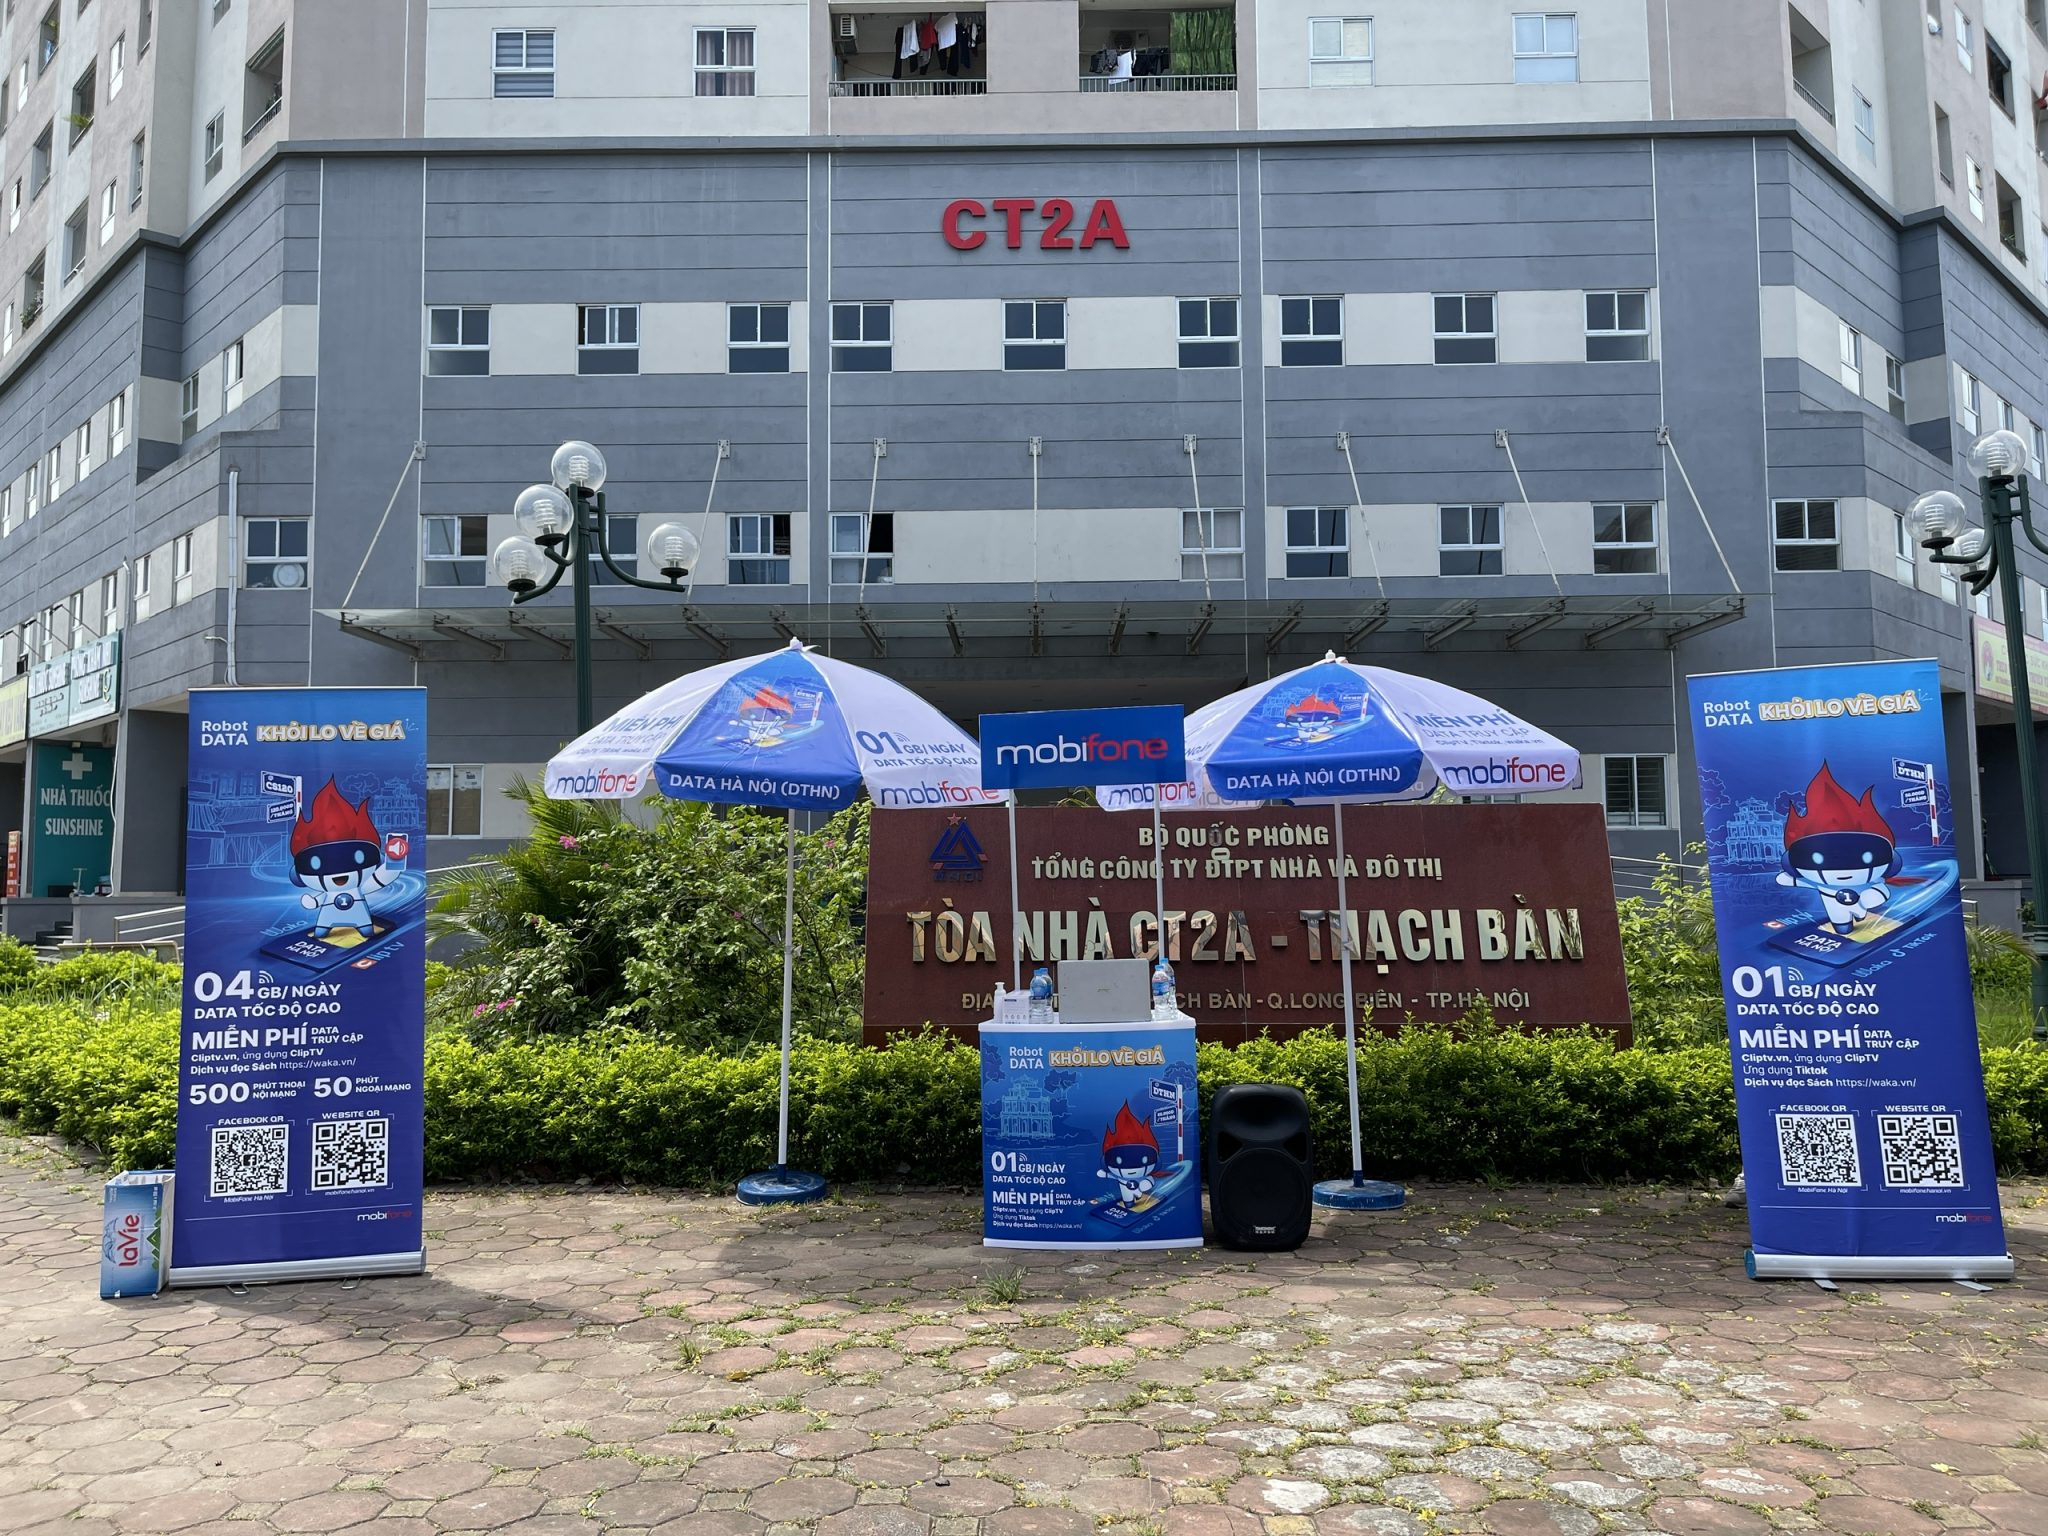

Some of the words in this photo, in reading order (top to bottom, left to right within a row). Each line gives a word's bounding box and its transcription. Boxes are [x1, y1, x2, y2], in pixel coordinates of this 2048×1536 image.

[943, 198, 1130, 250] CT2A
[1703, 700, 1751, 713] Robot
[1758, 697, 1814, 722] KHỎI
[1815, 699, 1846, 717] LO
[1845, 693, 1878, 716] VỀ
[1878, 690, 1921, 713] GIÁ
[1468, 708, 1517, 727] PHÍ
[1704, 713, 1753, 728] DATA
[201, 720, 248, 732] Robot
[256, 720, 308, 742] KHỎI
[310, 725, 338, 741] LO
[338, 721, 367, 741] VỀ
[369, 720, 406, 740] GIÁ
[201, 733, 248, 746] DATA
[1422, 729, 1458, 738] DATA
[1459, 729, 1498, 738] TRUY
[856, 730, 903, 755] 01
[904, 743, 928, 755] GB/
[931, 741, 966, 753] NGÀY
[996, 733, 1168, 765] mobifone
[874, 758, 908, 768] DATA
[910, 757, 933, 766] TỐC
[936, 756, 952, 767] ĐỘ
[954, 757, 978, 766] CAO
[1442, 757, 1566, 784] mobifone
[554, 768, 637, 793] mobifone
[1227, 775, 1273, 790] DATA
[1277, 771, 1301, 787] HÀ
[1305, 768, 1334, 786] NỘI
[1338, 766, 1400, 783] (DTHN)
[1897, 766, 1925, 780] DTHN
[41, 785, 66, 806] NHÀ
[71, 784, 110, 806] THUỐC
[266, 781, 293, 793] CS120
[670, 774, 715, 789] DATA
[721, 775, 743, 791] HÀ
[749, 778, 776, 793] NỘI
[781, 781, 840, 800] (DTHN)
[881, 781, 1000, 805] mobifone
[45, 818, 103, 836] SUNSHINE
[1138, 823, 1169, 850] BỘ
[1175, 821, 1240, 848] QUỐC
[1247, 822, 1330, 847] PHÒNG
[1032, 851, 1095, 879] TỔNG
[1100, 855, 1163, 879] CÔNG
[1170, 858, 1197, 879] TY
[1205, 858, 1263, 879] ĐTPT
[1270, 854, 1322, 879] NHÀ
[1366, 854, 1400, 878] ĐÔ
[1404, 858, 1443, 881] THỊ
[906, 898, 997, 963] TÒA
[1018, 897, 1113, 962] NHÀ
[1129, 910, 1257, 963] CT2A
[1300, 908, 1465, 975] THẠCH
[1476, 894, 1584, 961] BÀN
[194, 970, 254, 1002] 04
[258, 986, 288, 999] GB/
[292, 981, 341, 998] NGÀY
[1732, 966, 1785, 998] 01
[1788, 984, 1820, 998] GB/
[1825, 980, 1876, 997] NGÀY
[962, 993, 994, 1013] ĐỊA
[1208, 988, 1252, 1009] BÀN
[1267, 992, 1345, 1010] Q.LONG
[1355, 989, 1402, 1009] BIÊN
[1494, 988, 1530, 1011] NỘI
[1737, 1004, 1779, 1015] DATA
[1782, 1001, 1815, 1015] TỐC
[1817, 1001, 1842, 1017] ĐỘ
[1846, 1003, 1879, 1015] CAO
[195, 1007, 237, 1019] DATA
[241, 1002, 276, 1016] TỐC
[278, 1002, 301, 1017] ĐỘ
[305, 1002, 341, 1014] CAO
[192, 1025, 259, 1050] MIỄN
[265, 1022, 308, 1046] PHÍ
[312, 1027, 339, 1035] DATA
[312, 1035, 339, 1044] TRUY
[342, 1033, 364, 1044] CẬP
[1739, 1024, 1808, 1048] MIỄN
[1814, 1024, 1860, 1048] PHÍ
[1864, 1030, 1892, 1038] DATA
[1865, 1040, 1893, 1048] TRUY
[1896, 1038, 1919, 1049] CẬP
[191, 1053, 239, 1063] Cliptv.vn,
[242, 1051, 261, 1061] ứng
[264, 1050, 287, 1060] dụng
[290, 1048, 324, 1059] ClipTV
[1010, 1047, 1043, 1057] Robot
[1050, 1048, 1088, 1066] KHỎI
[1089, 1051, 1112, 1066] LO
[1111, 1047, 1135, 1065] VỀ
[1136, 1046, 1165, 1065] GIÁ
[1010, 1059, 1044, 1069] DATA
[1742, 1053, 1792, 1063] Cliptv.vn,
[1795, 1053, 1813, 1064] ứng
[1816, 1053, 1842, 1064] dụng
[1845, 1053, 1879, 1063] ClipTV
[191, 1064, 213, 1075] Dịch
[215, 1065, 229, 1074] vụ
[230, 1063, 250, 1073] đọc
[252, 1061, 277, 1071] Sách
[279, 1057, 357, 1070] https://waka.vn/
[1743, 1064, 1765, 1076] Ứng
[1767, 1066, 1792, 1076] dụng
[1795, 1065, 1828, 1075] Tiktok
[279, 1081, 306, 1089] THOẠI
[313, 1076, 353, 1098] 50
[356, 1076, 380, 1084] PHÚT
[356, 1085, 384, 1093] NGOẠI
[384, 1083, 412, 1092] MẠNG
[1744, 1078, 1769, 1088] Dịch
[1771, 1080, 1784, 1088] vụ
[1786, 1078, 1805, 1088] đọc
[1807, 1077, 1833, 1087] Sách
[1836, 1078, 1916, 1088] https://waka.vn/
[189, 1082, 250, 1105] 500
[253, 1090, 269, 1099] NỘI
[270, 1090, 297, 1098] MẠNG
[1153, 1087, 1175, 1099] DTHN
[218, 1116, 269, 1126] FACEBOOK
[271, 1115, 284, 1123] QR
[322, 1110, 364, 1119] WEBSITE
[366, 1109, 380, 1117] QR
[991, 1151, 1017, 1172] 01
[1018, 1164, 1036, 1173] GB/
[1037, 1161, 1065, 1173] NGÀY
[992, 1175, 1013, 1183] DATA
[1015, 1174, 1032, 1184] TỐC
[1033, 1175, 1046, 1186] ĐỘ
[992, 1188, 1028, 1205] MIỄN
[1030, 1189, 1054, 1206] PHÍ
